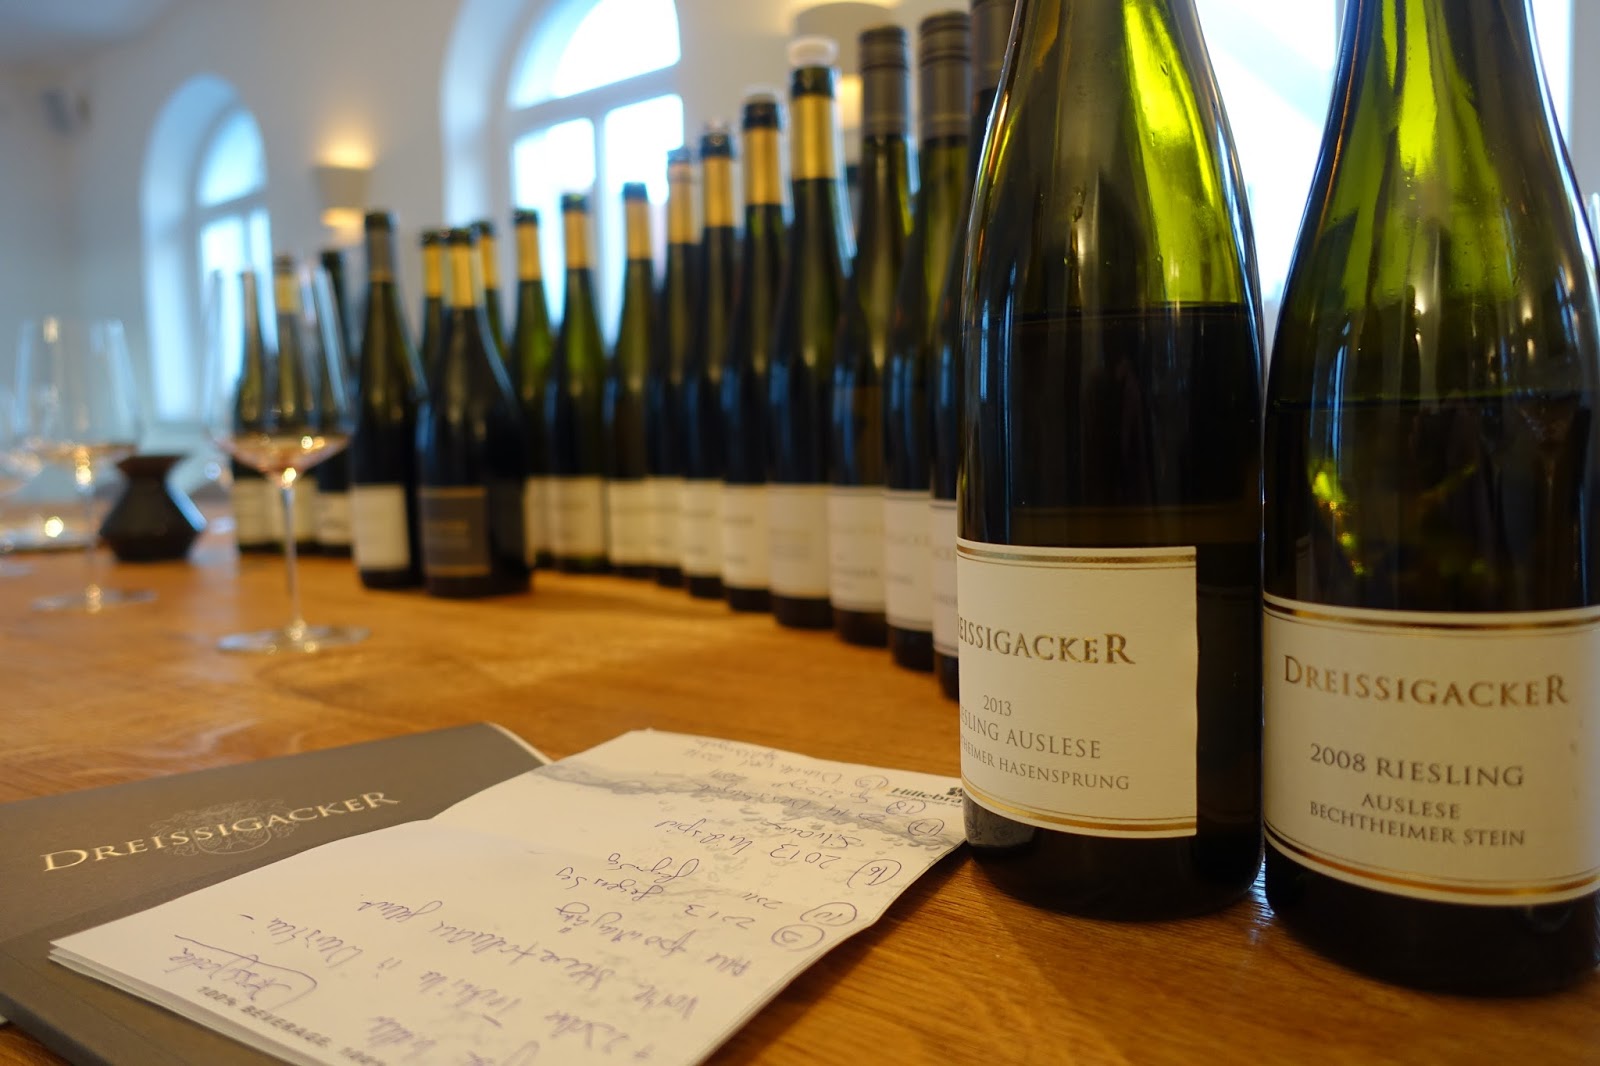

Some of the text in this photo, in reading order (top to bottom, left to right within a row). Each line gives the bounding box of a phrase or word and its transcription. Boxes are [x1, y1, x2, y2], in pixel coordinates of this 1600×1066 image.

[958, 615, 1135, 665] EISSIGACKER
[1283, 654, 1569, 708] DREISSIGACKER
[982, 694, 1012, 717] 2013
[961, 706, 1101, 759] ESLING AUSLESE
[1000, 757, 1130, 790] HASENSPRUNG
[1309, 742, 1525, 788] 2008 RIESLING
[891, 787, 963, 804] Hillebra
[1361, 792, 1462, 820] AUSLESE
[40, 791, 399, 872] DREISSIGACKER
[1309, 801, 1526, 847] BECHTHEIMER STEIN
